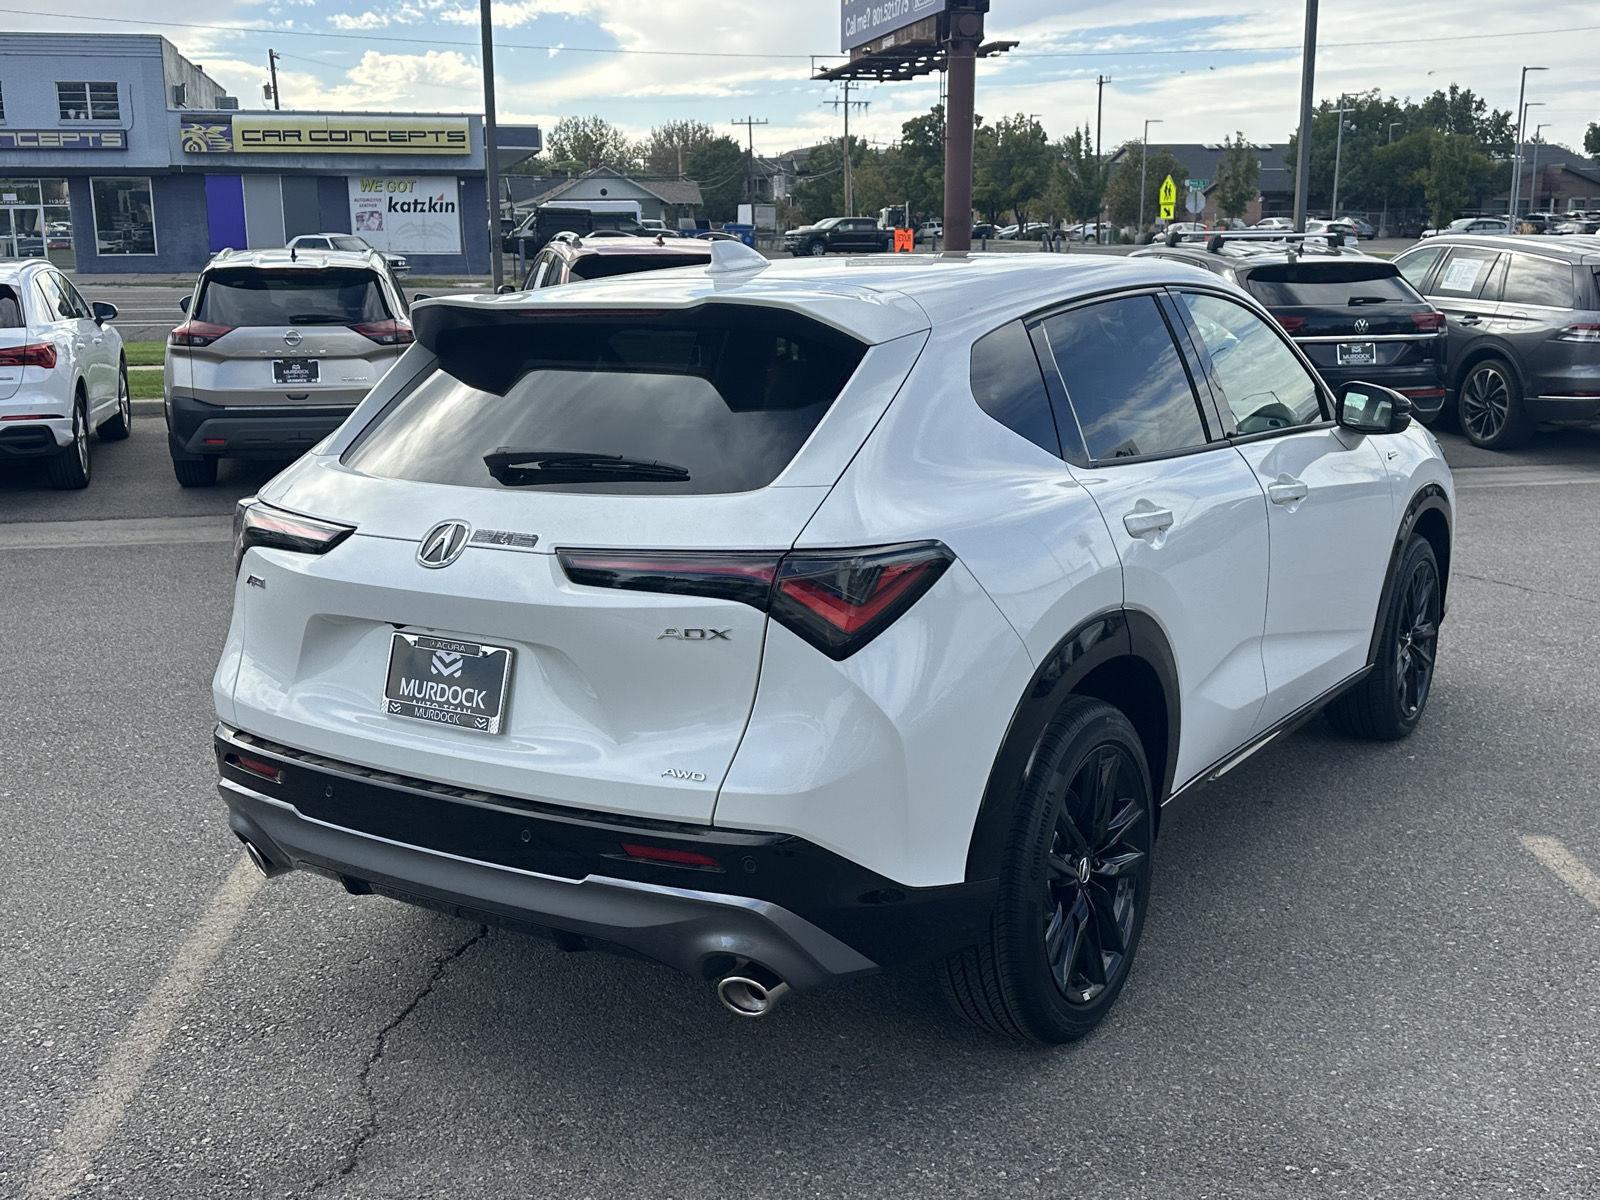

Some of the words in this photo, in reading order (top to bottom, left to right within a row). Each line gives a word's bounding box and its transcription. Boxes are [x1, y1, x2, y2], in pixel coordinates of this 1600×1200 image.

[845, 14, 857, 37] Call
[857, 7, 871, 33] me?
[241, 129, 302, 142] CAR
[309, 130, 466, 142] CONCEPTS
[360, 179, 383, 193] WE
[386, 180, 416, 193] GOT
[387, 193, 455, 213] katzkin
[656, 628, 734, 641] ADX
[436, 642, 466, 652] ACURA
[399, 677, 487, 709] MURDOCK
[414, 707, 461, 724] MURDOCK
[661, 768, 706, 782] AWD
